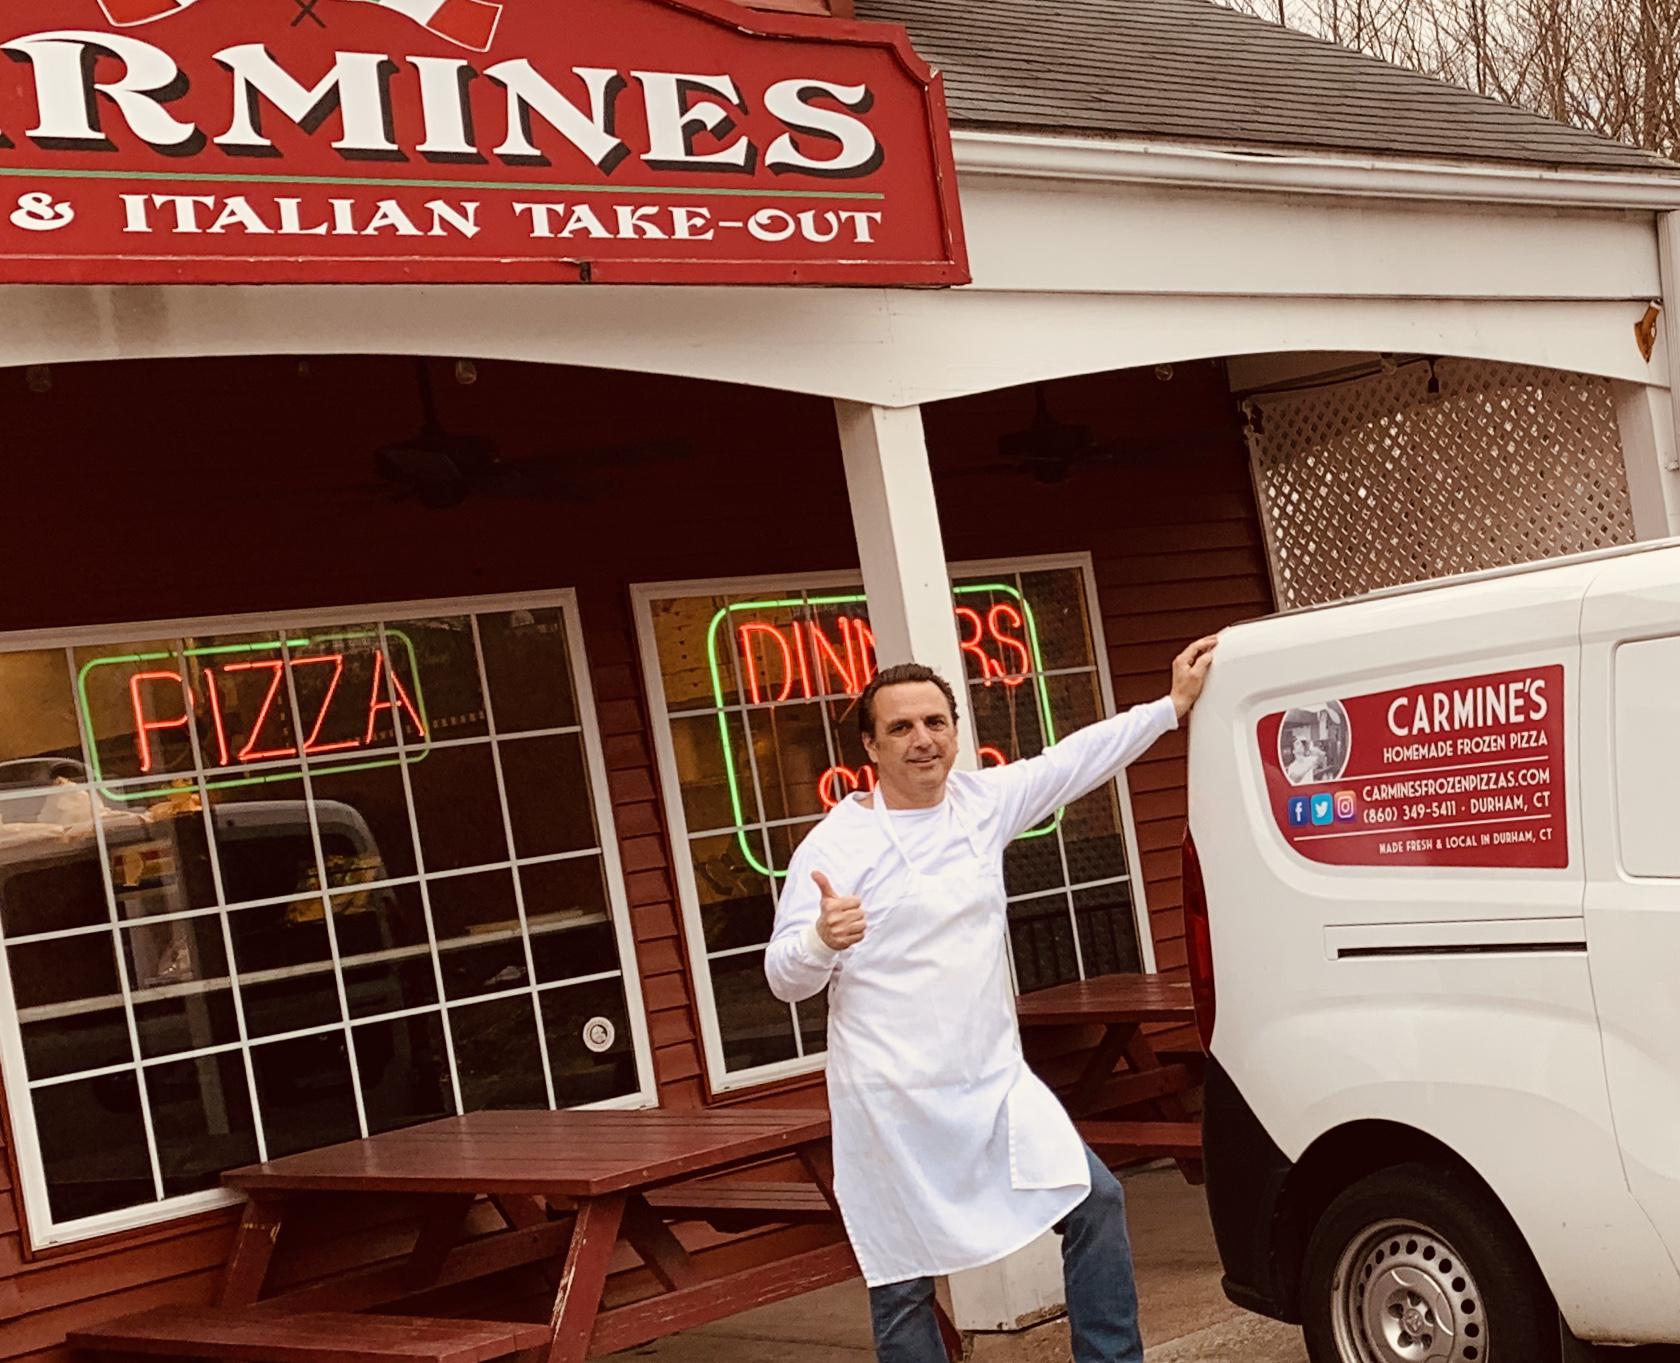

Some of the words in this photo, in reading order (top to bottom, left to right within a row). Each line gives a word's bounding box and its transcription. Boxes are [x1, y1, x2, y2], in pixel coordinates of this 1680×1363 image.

[0, 30, 883, 176] RMINES
[9, 192, 75, 231] &
[119, 193, 481, 239] ITALIAN
[512, 202, 882, 243] TAKE-OUT
[739, 603, 1029, 705] DINRS
[130, 648, 426, 773] PIZZA
[1387, 678, 1548, 737] CARMINE'S
[1383, 740, 1454, 764] HOMEMADE
[1457, 734, 1506, 756] FROZEN
[1510, 729, 1549, 750] PIZZA
[1362, 766, 1551, 802] CARMINESFROZENPIZZAS.COM
[1363, 806, 1398, 824] (860)
[1403, 800, 1456, 820] 349-5411
[1470, 794, 1529, 814] DURHAM,
[1533, 790, 1551, 807] CT
[1379, 841, 1404, 855] MADE
[1406, 838, 1433, 852] FRESH
[1436, 837, 1443, 850] &
[1446, 833, 1478, 849] LOCAL
[1481, 832, 1490, 846] IN
[1493, 829, 1537, 844] DURHAM,
[1539, 827, 1552, 840] CT
